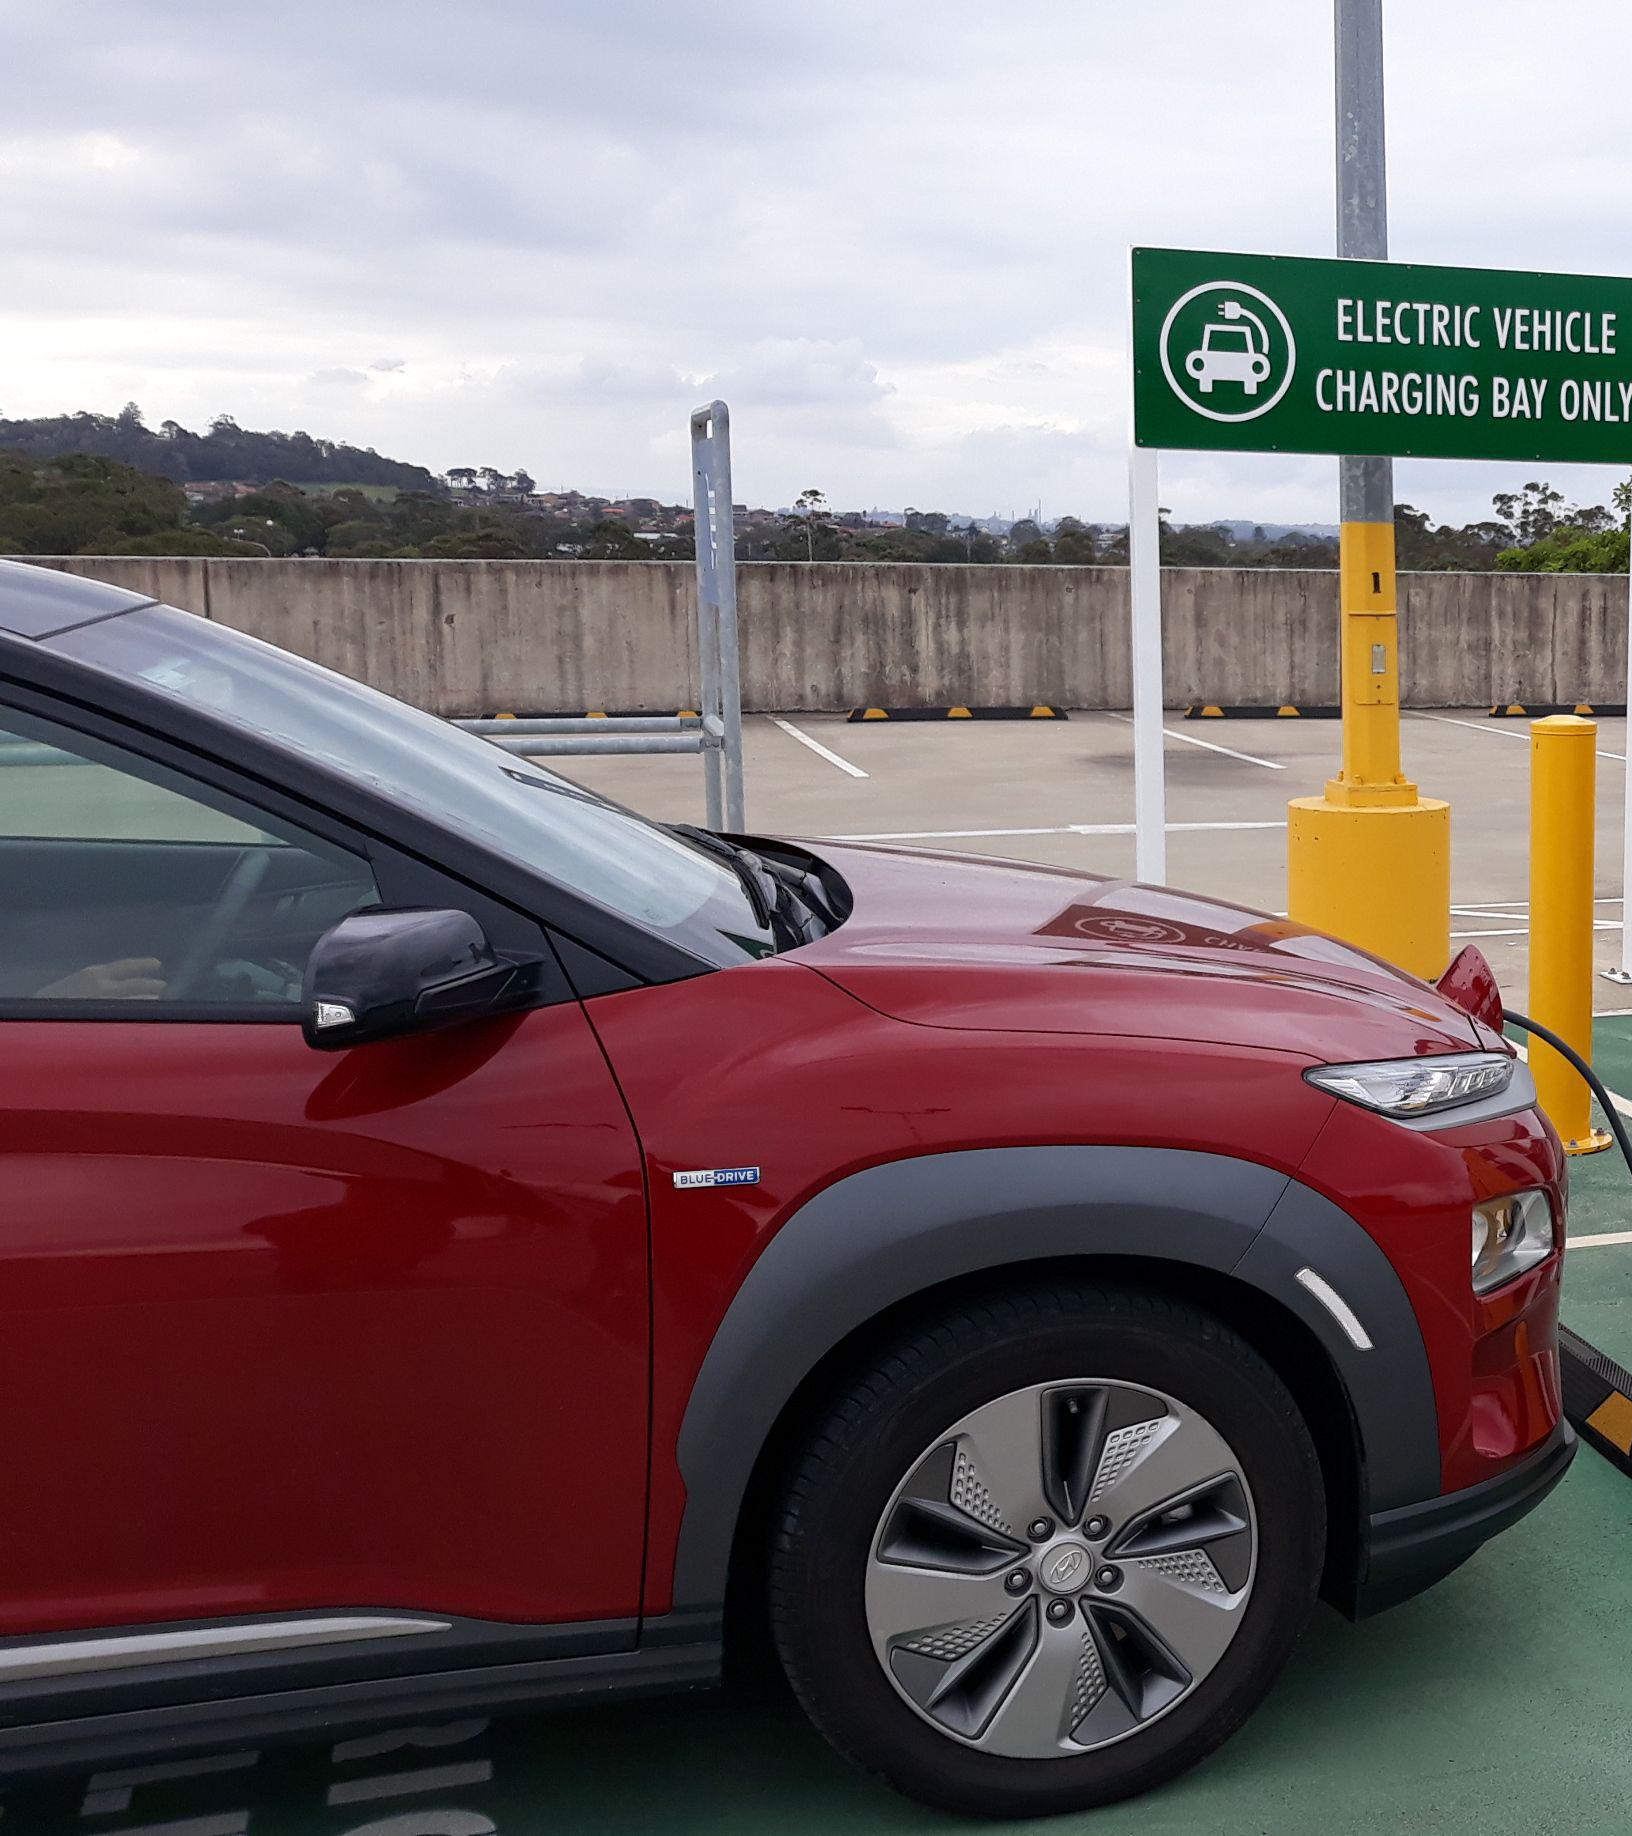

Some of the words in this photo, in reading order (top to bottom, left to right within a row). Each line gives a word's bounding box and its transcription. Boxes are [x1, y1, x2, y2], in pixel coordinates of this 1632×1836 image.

[1337, 298, 1480, 348] ELECTRIC
[1493, 307, 1616, 354] VEHICLE
[1316, 368, 1479, 417] CHARGING
[1492, 376, 1548, 419] BAY
